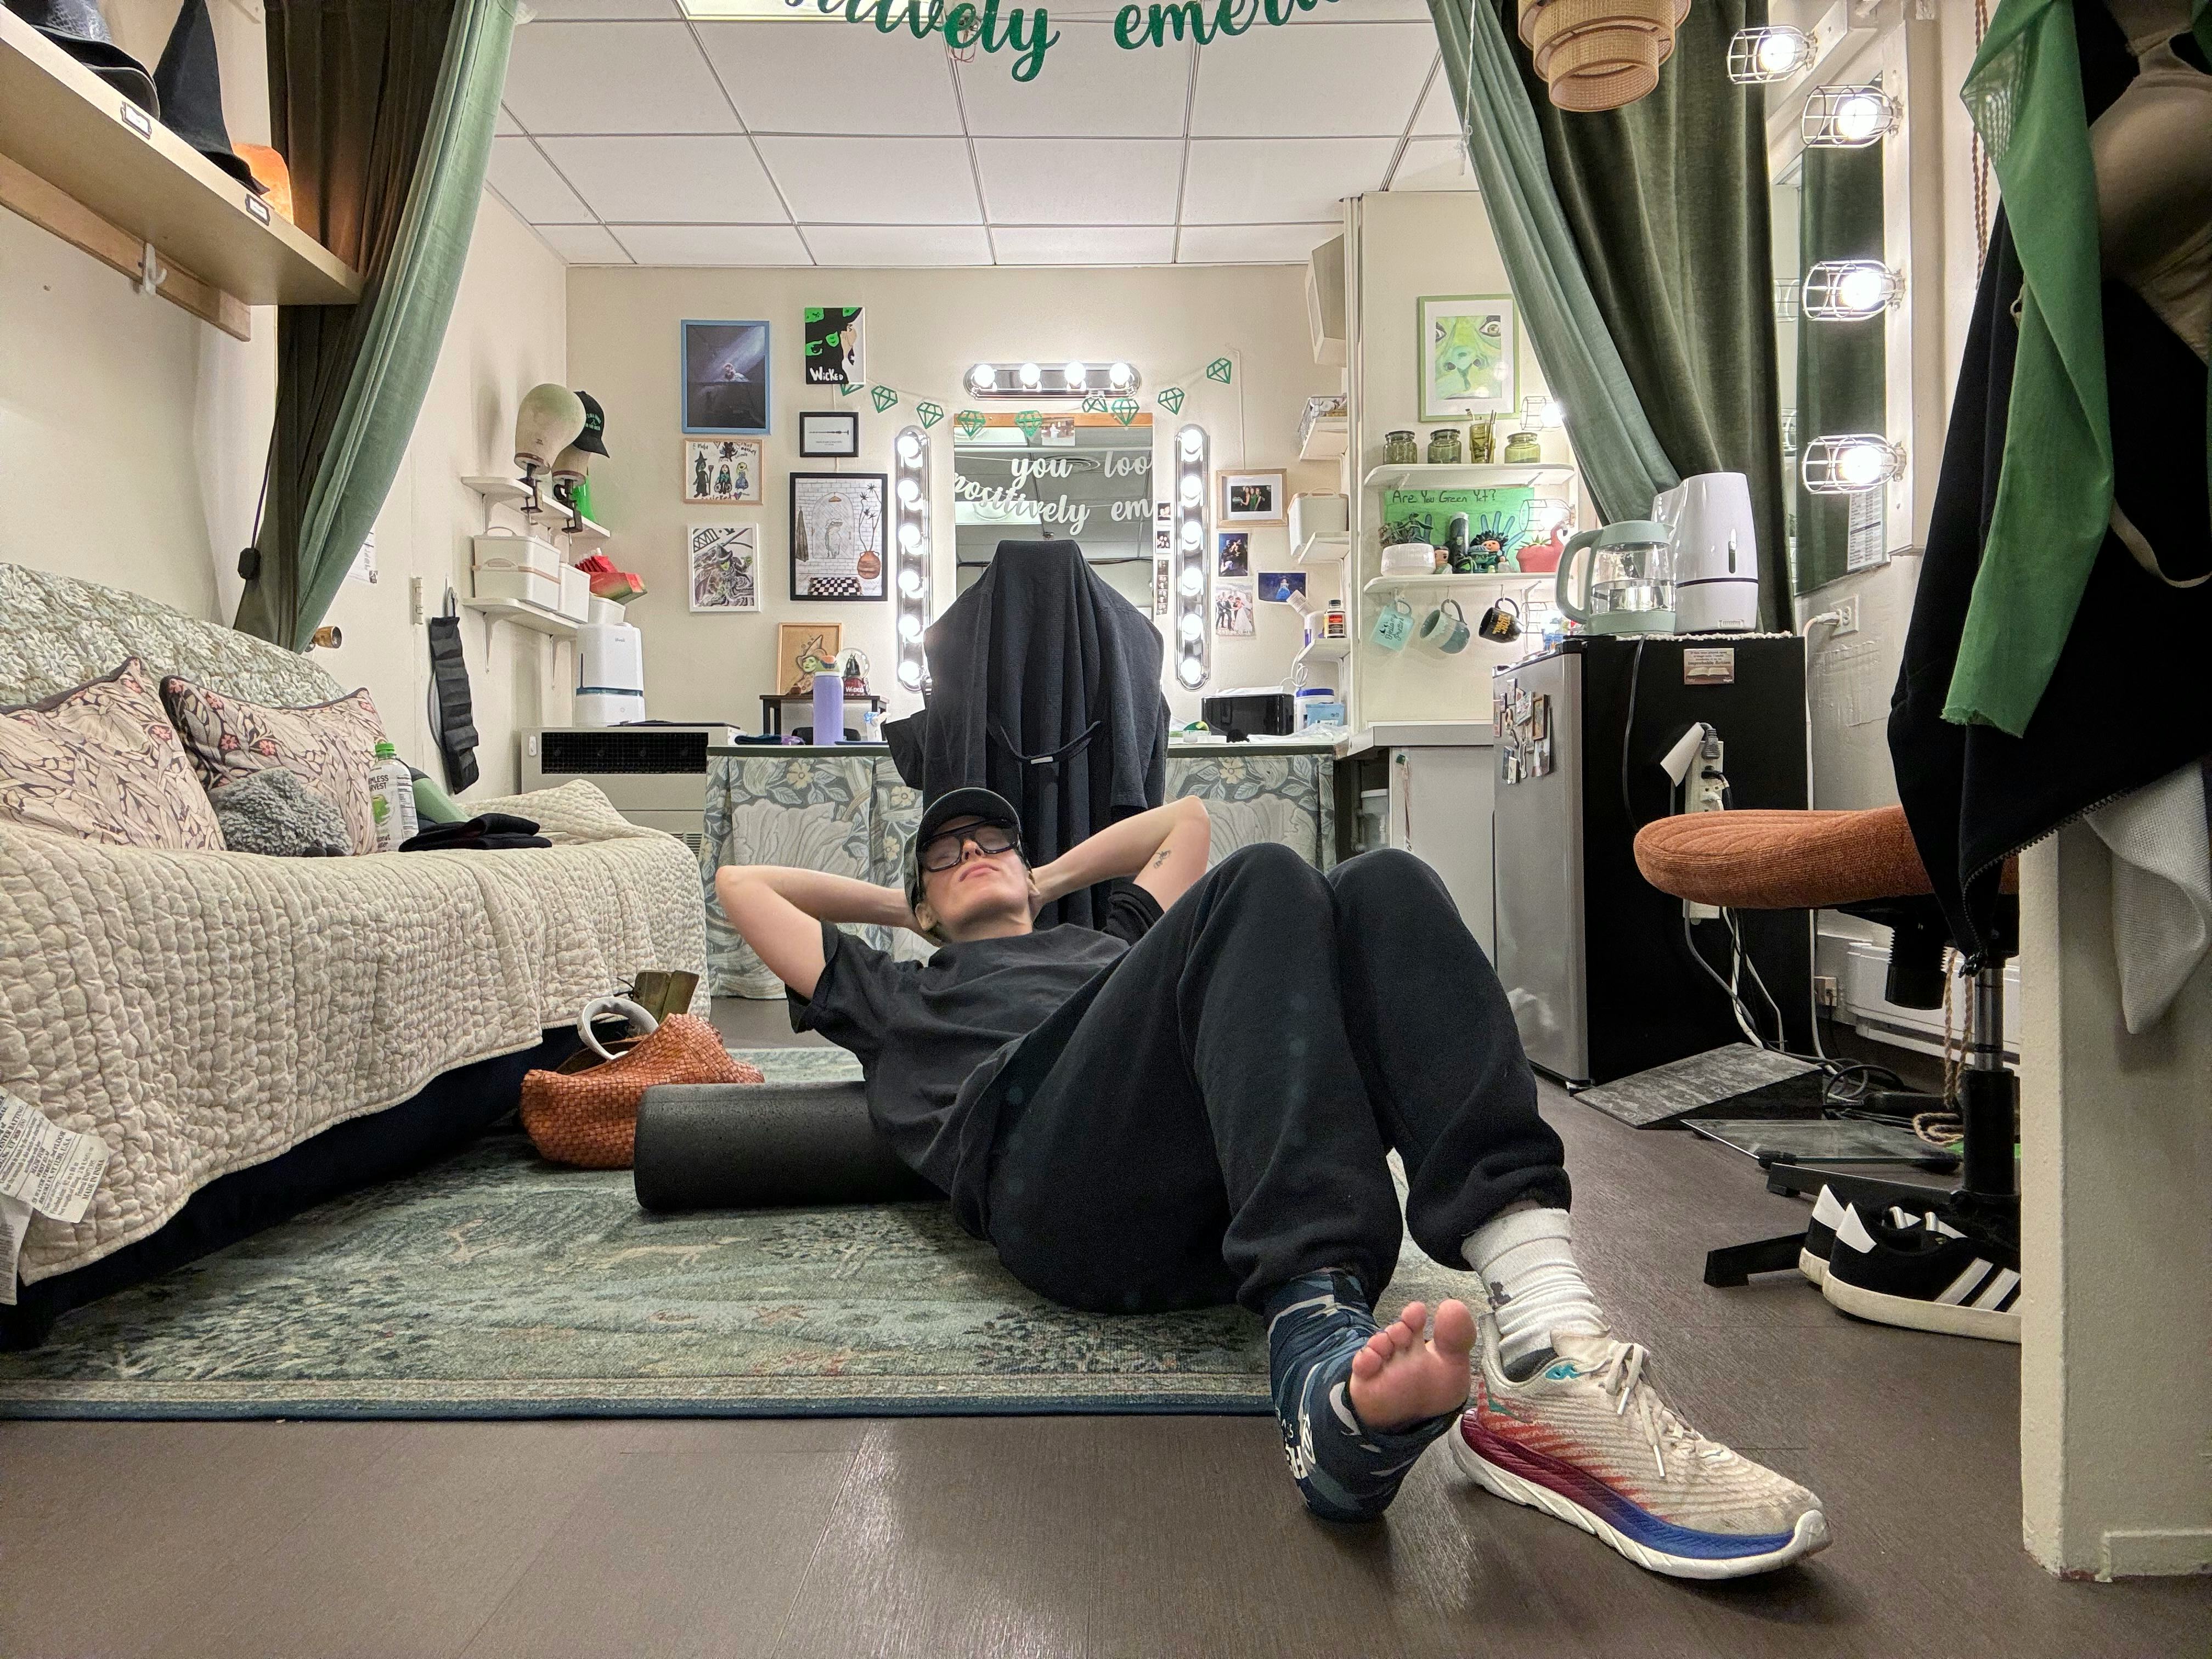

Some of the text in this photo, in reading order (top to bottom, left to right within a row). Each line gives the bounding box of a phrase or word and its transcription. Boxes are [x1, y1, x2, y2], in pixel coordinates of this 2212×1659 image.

[785, 0, 1060, 82] ively
[1012, 452, 1153, 490] you loo
[1111, 499, 1153, 521] em
[1392, 489, 1496, 503] Are You Green Yet?
[53, 1130, 66, 1150] FLOOR
[81, 1158, 106, 1200] MADE IN INDIA
